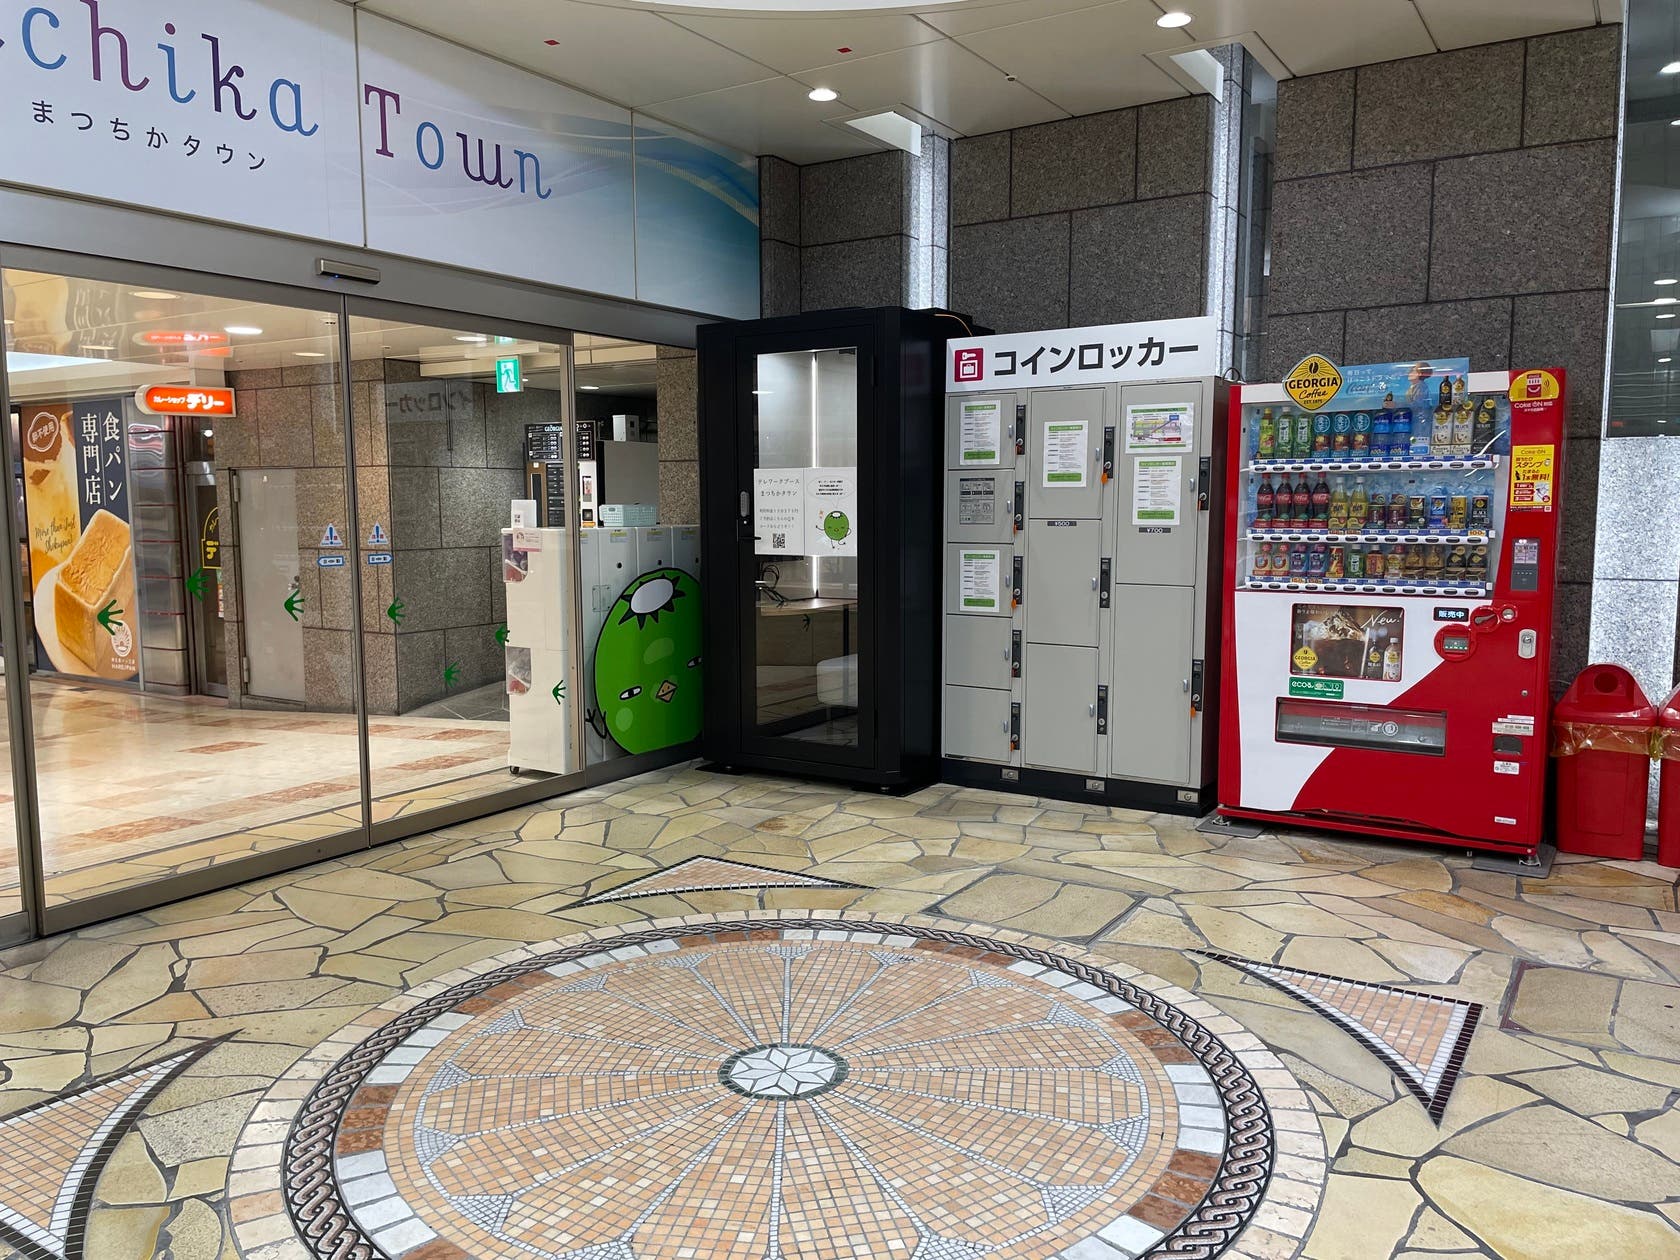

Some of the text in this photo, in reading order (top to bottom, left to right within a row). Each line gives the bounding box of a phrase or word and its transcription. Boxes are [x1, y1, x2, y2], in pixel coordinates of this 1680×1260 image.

[0, 0, 552, 199] chika Town
[32, 100, 266, 170] まつちかタウン
[994, 337, 1199, 376] コインロッカー
[1288, 377, 1339, 390] GEORGIA
[1299, 388, 1328, 400] Coffee
[186, 393, 225, 410] デリー
[80, 413, 101, 505] 専門店
[102, 411, 122, 501] 食パン
[1360, 609, 1403, 629] New!
[1438, 610, 1465, 619] 販売中
